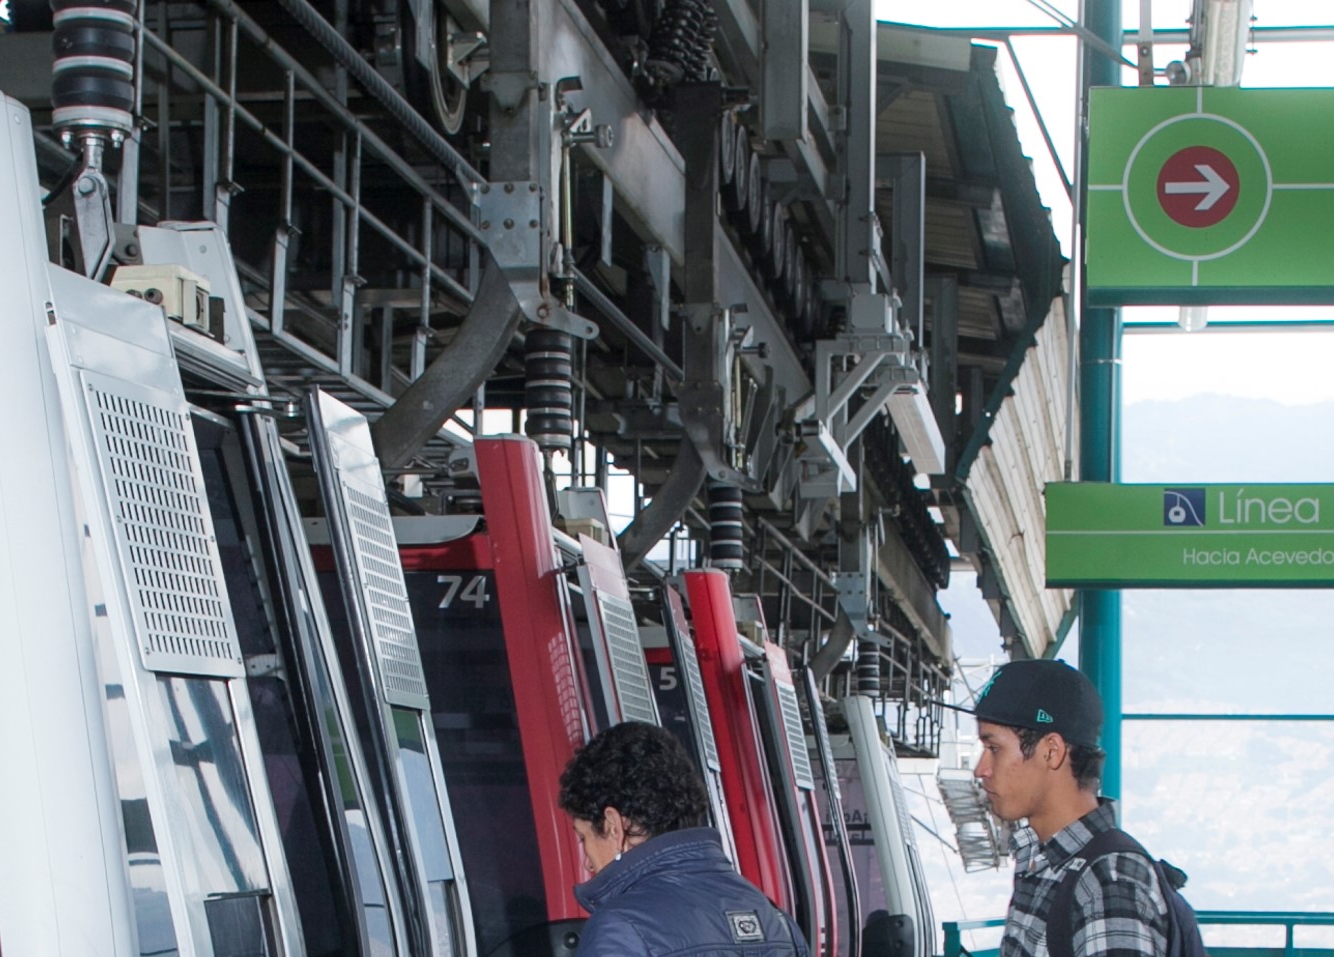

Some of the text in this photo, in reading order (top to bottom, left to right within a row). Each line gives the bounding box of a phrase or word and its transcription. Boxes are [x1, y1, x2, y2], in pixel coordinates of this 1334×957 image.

[1219, 488, 1320, 524] Línea
[1182, 547, 1241, 566] Hacia
[436, 574, 491, 610] 74
[658, 666, 678, 691] 5
